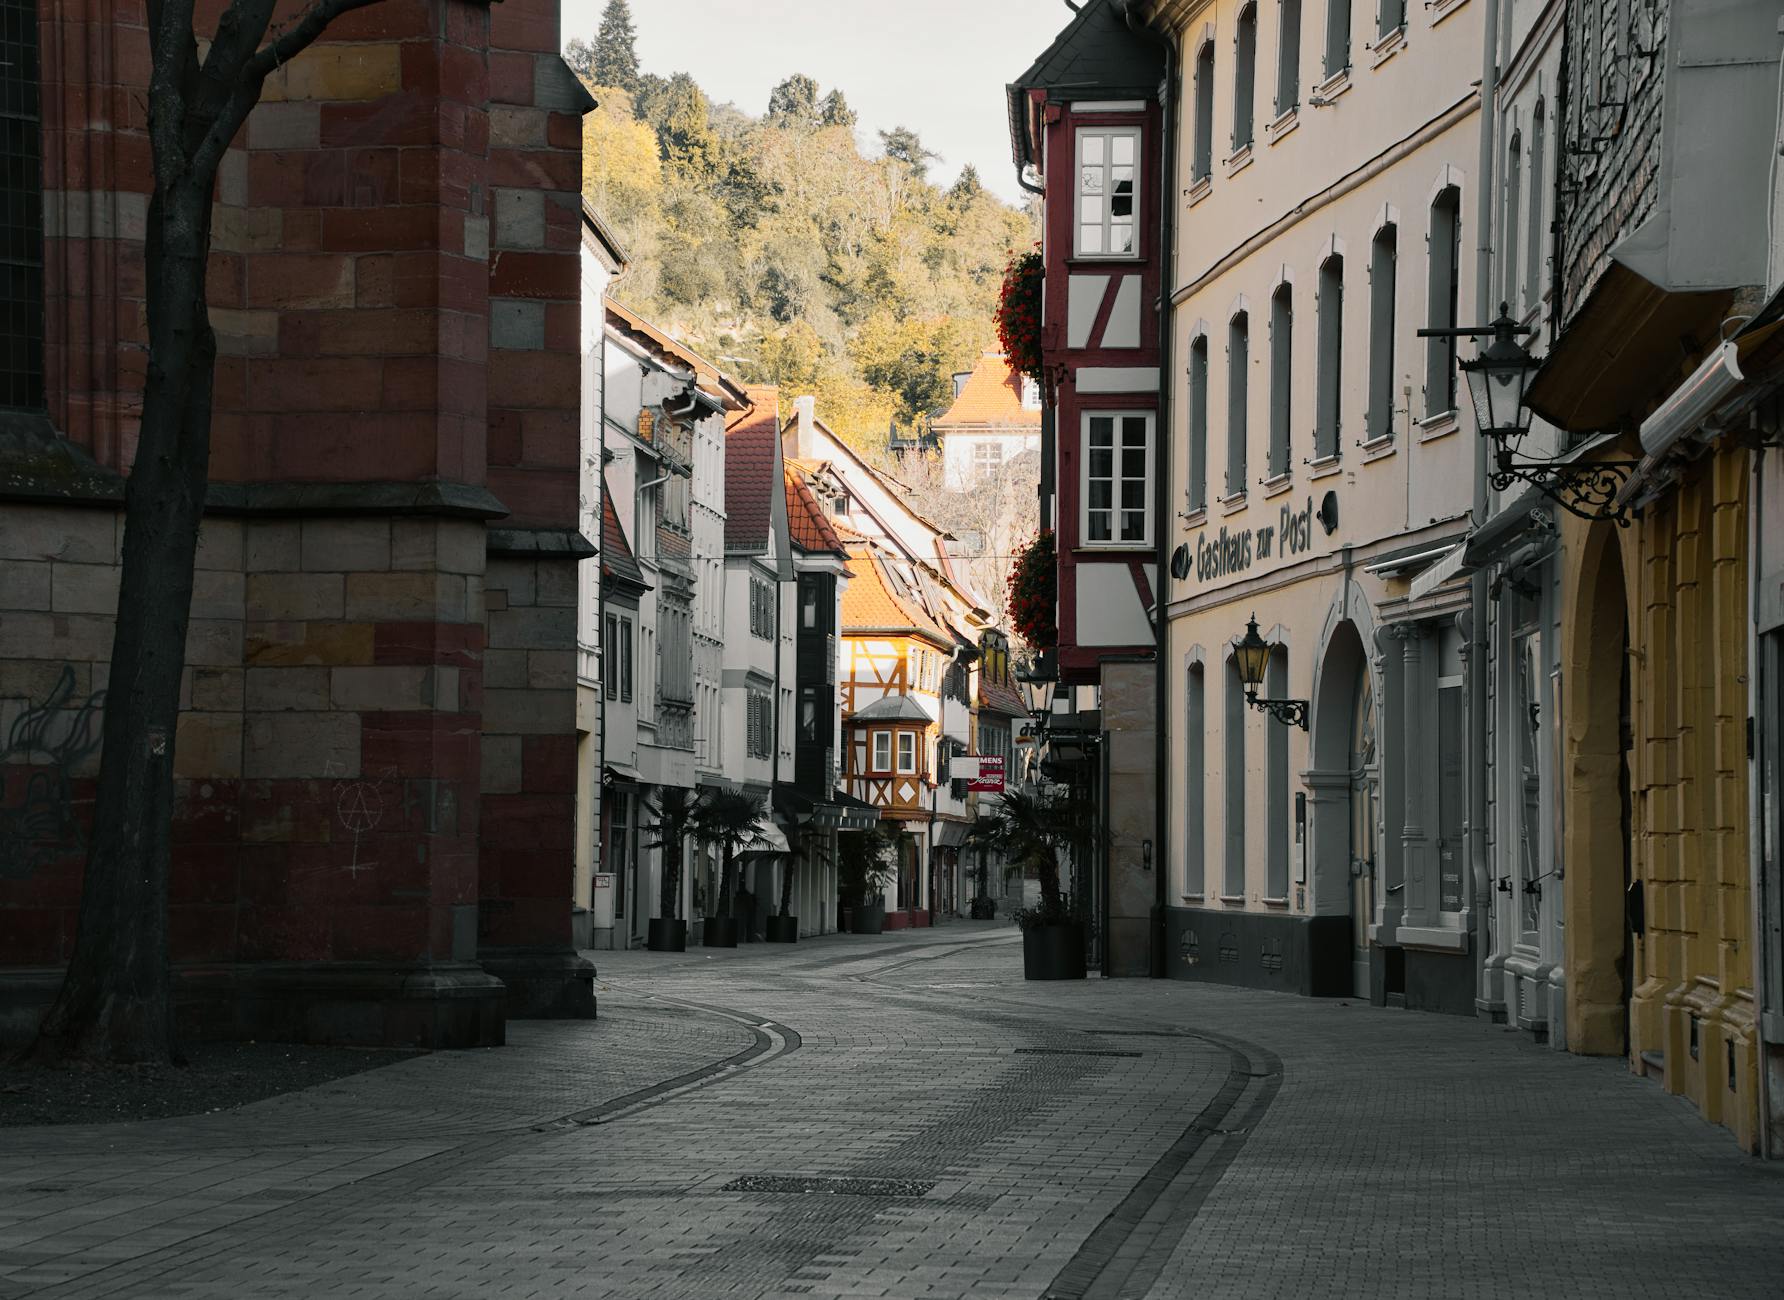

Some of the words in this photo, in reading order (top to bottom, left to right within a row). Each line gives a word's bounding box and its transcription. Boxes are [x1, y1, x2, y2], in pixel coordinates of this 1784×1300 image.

[1197, 526, 1252, 583] Gasthaus
[1256, 526, 1274, 560] zur
[1280, 496, 1312, 558] Post
